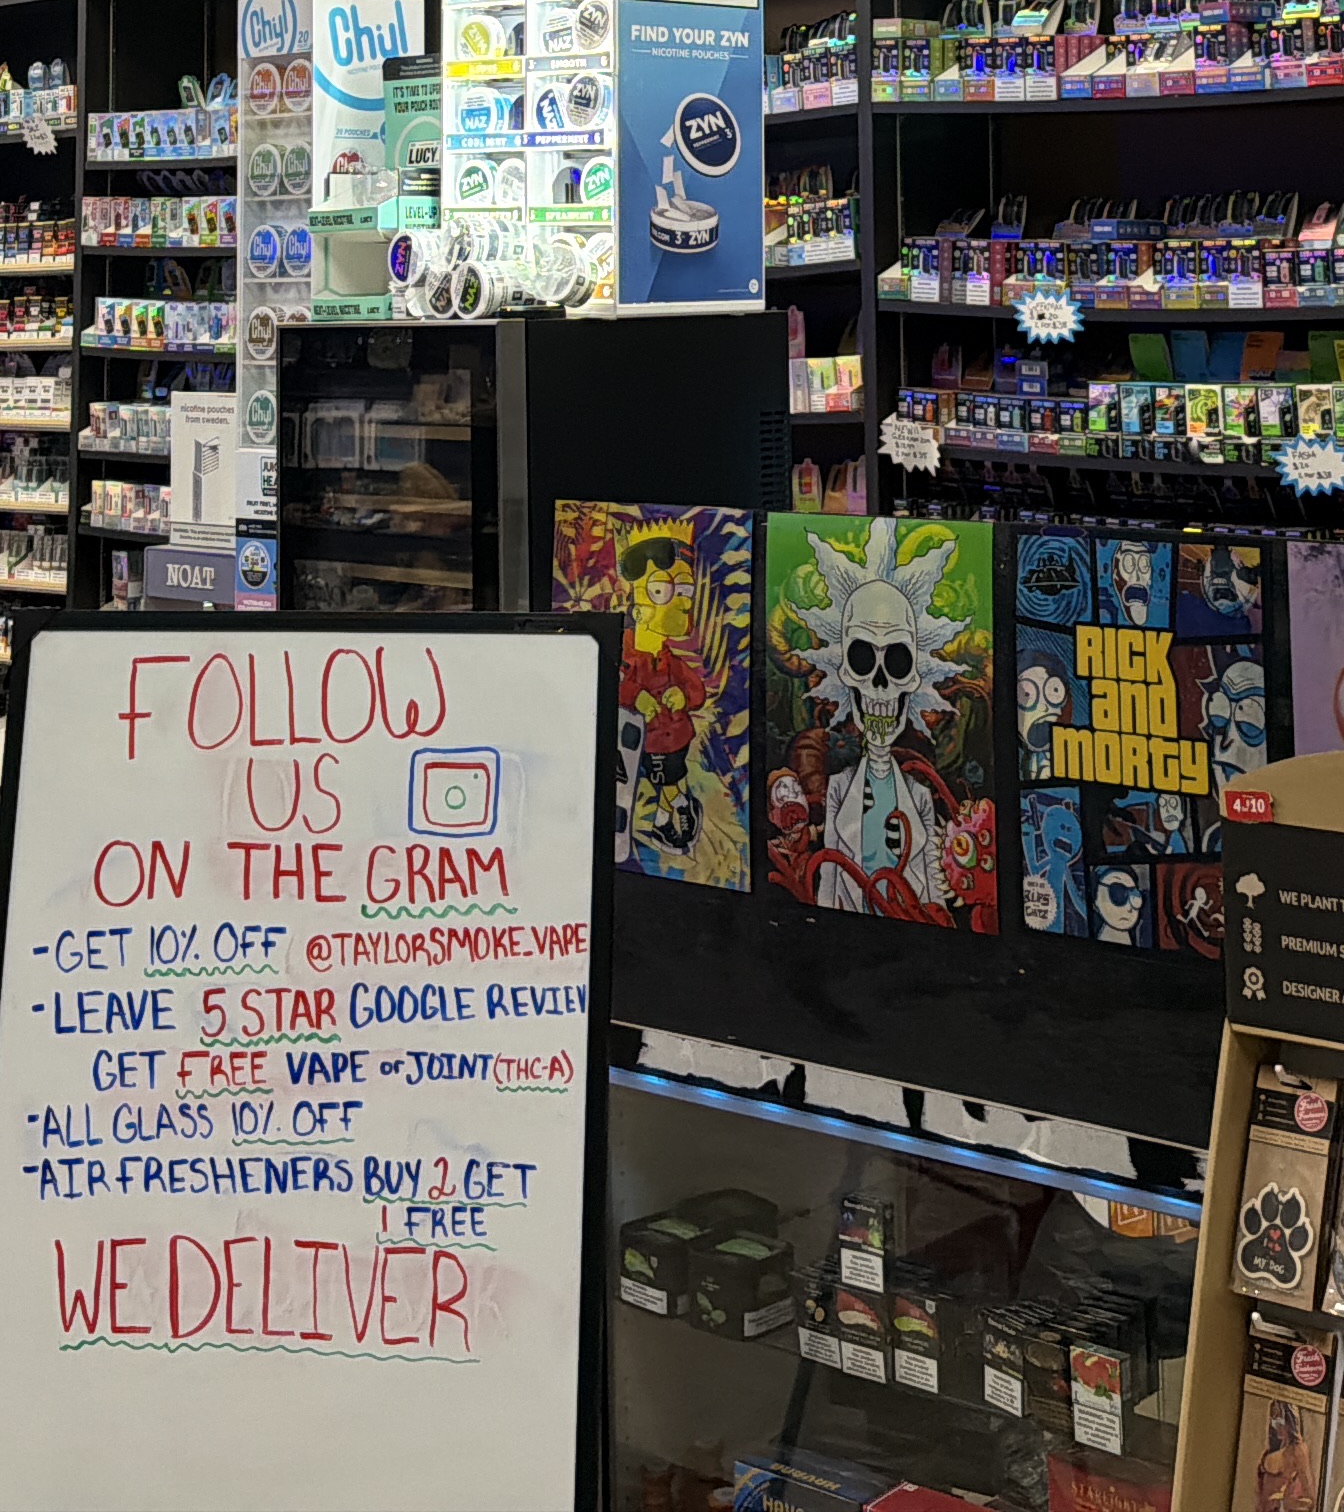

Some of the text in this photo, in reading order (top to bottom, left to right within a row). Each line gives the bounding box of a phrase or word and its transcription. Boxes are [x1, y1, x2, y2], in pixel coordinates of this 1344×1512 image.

[298, 30, 310, 43] 20
[631, 24, 749, 47] FIND YOUR ZYN
[651, 47, 730, 60] NICOTINE POUCHES
[685, 110, 726, 139] ZYN
[688, 231, 710, 245] ZYN
[180, 404, 235, 414] nicotine pouches
[185, 414, 230, 425] from sweden.
[166, 564, 215, 589] NOAT
[1075, 625, 1174, 683] RICK
[118, 646, 447, 760] FOLLOW
[1091, 680, 1178, 738] and
[247, 752, 342, 834] US
[93, 839, 510, 907] ON THE GRAM
[1279, 889, 1300, 906] WE
[1301, 892, 1339, 912] PLANT
[147, 932, 200, 967] 10%
[214, 925, 287, 969] OFF
[1281, 935, 1338, 959] PREMIUM
[1282, 980, 1340, 1005] DESIGNER
[200, 992, 227, 1036] 5
[242, 987, 337, 1037] STAR
[350, 982, 476, 1027] GOOGLE
[92, 1051, 166, 1090] GET
[177, 1050, 268, 1088] FREE
[287, 1053, 368, 1085] VAPE
[380, 1058, 406, 1079] or
[112, 1101, 214, 1142] GLASS
[232, 1103, 282, 1139] 10%
[293, 1100, 364, 1136] OFF
[114, 1155, 354, 1197] FRESHENERS
[364, 1159, 422, 1199] BUY
[428, 1157, 457, 1200] 2
[463, 1162, 537, 1199] GET
[380, 1206, 488, 1238] 1 FREE
[1253, 1255, 1285, 1275] MY DOG
[55, 1234, 472, 1353] WE DELIVER
